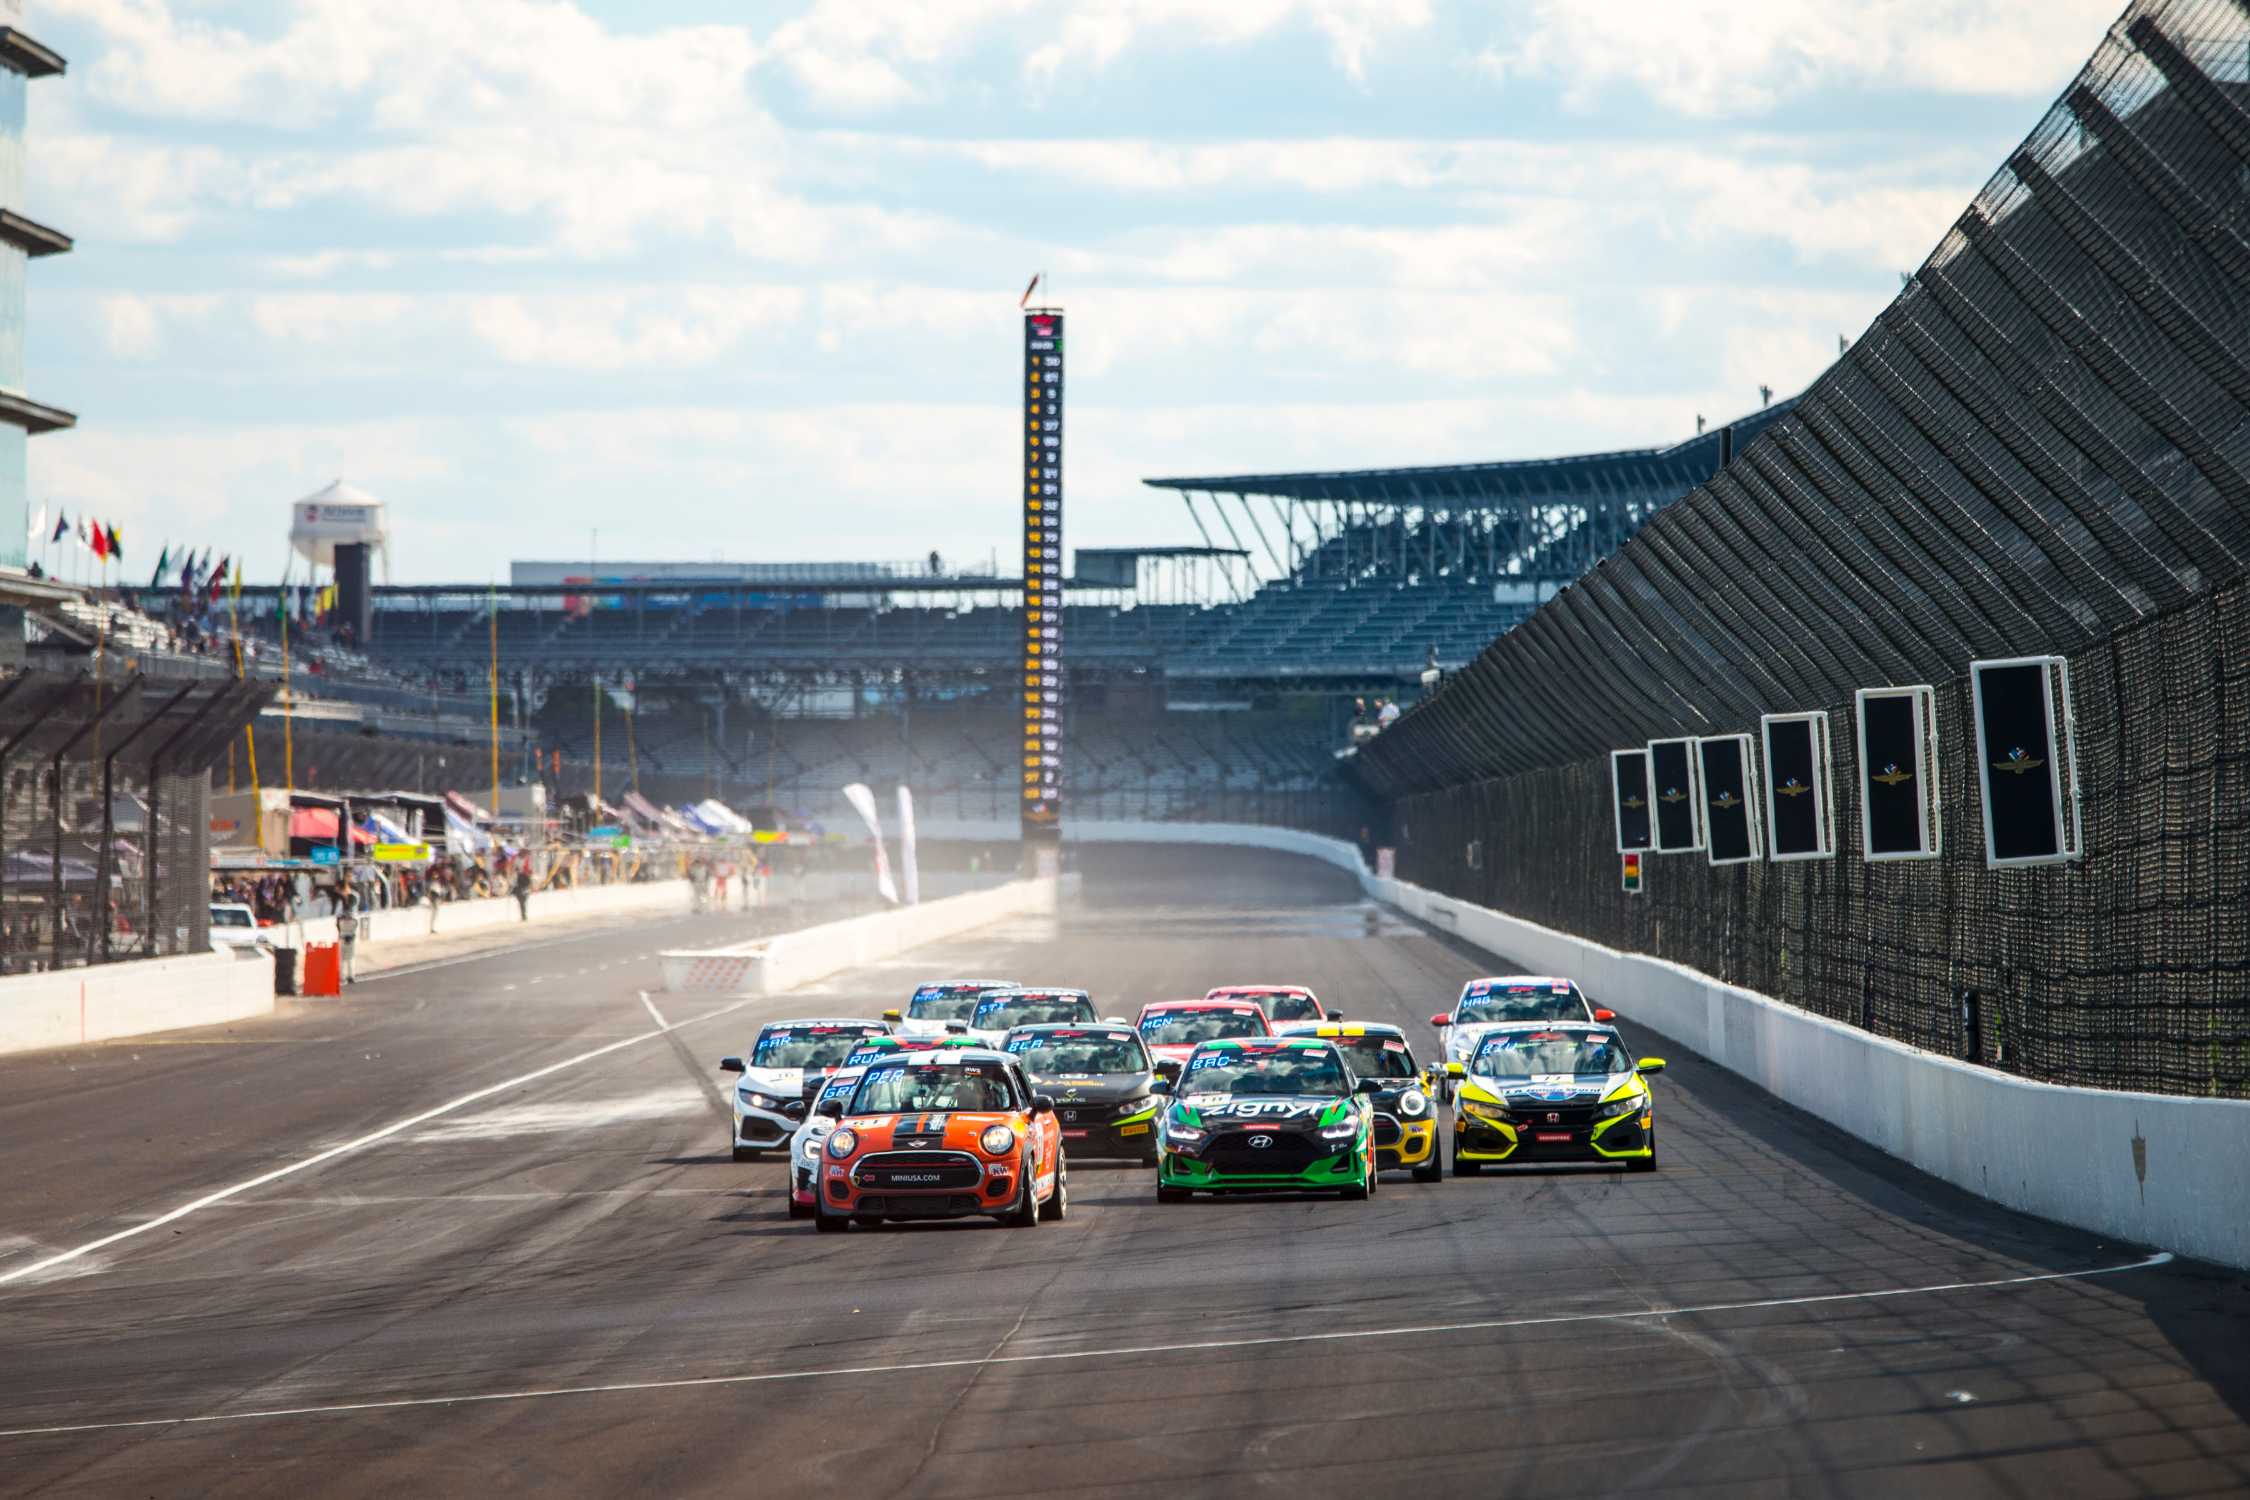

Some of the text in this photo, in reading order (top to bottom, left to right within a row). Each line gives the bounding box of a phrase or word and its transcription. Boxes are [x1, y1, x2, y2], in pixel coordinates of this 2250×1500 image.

[758, 1037, 793, 1051] FAR
[865, 1069, 904, 1086] PER
[891, 1174, 941, 1182] MINIUSA.COM
